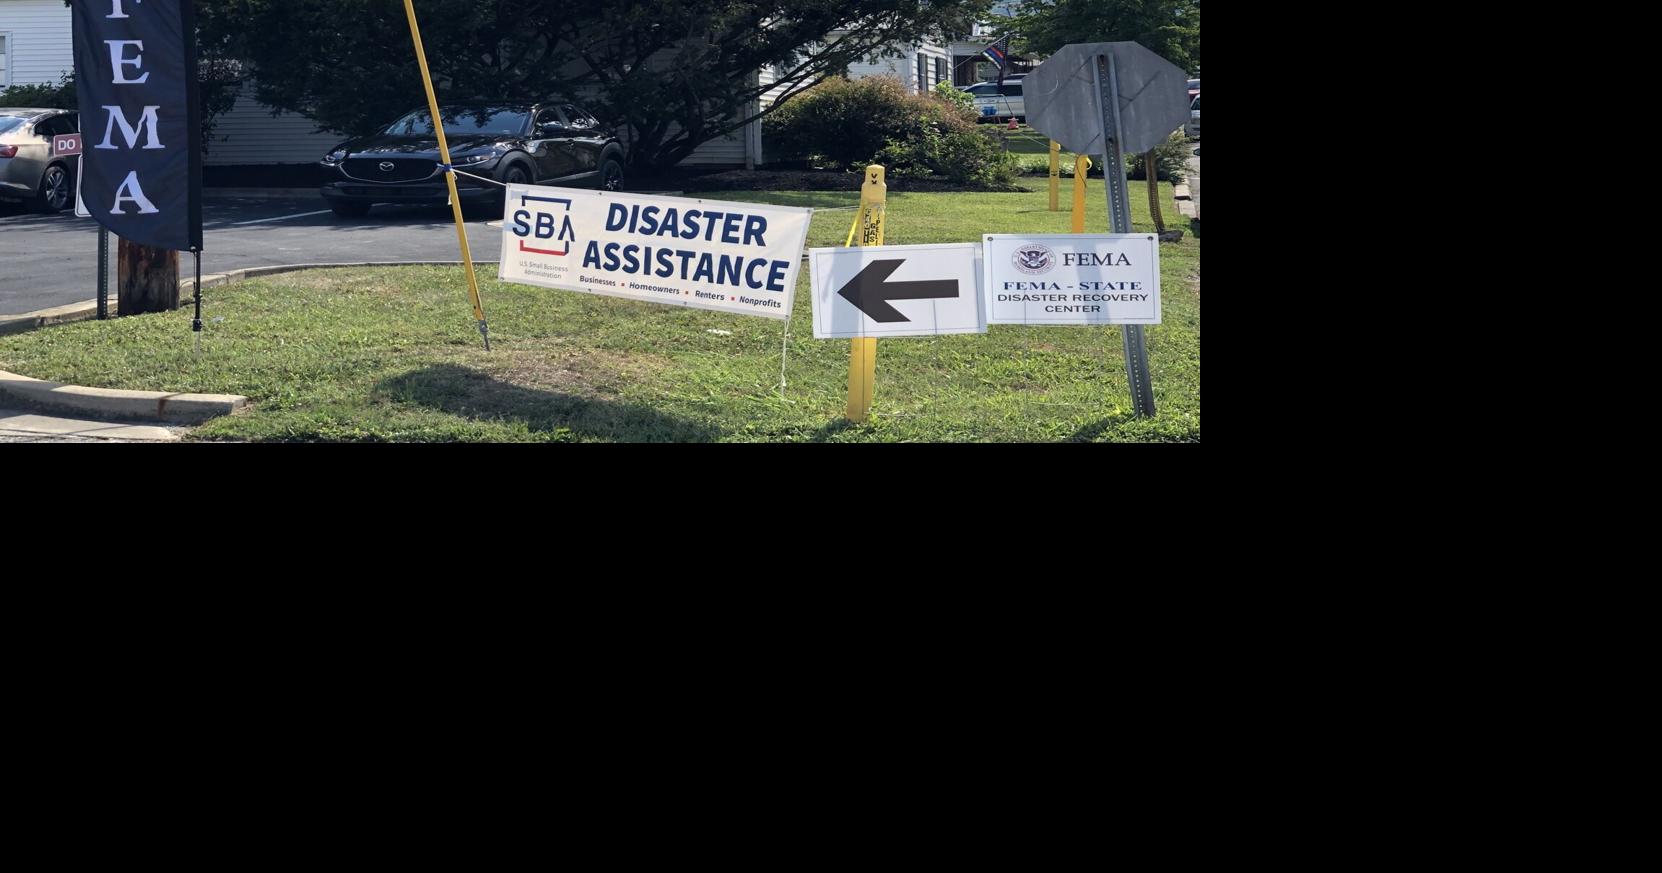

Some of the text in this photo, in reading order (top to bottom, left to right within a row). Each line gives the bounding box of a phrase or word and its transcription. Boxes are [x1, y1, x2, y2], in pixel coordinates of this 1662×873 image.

[58, 139, 76, 151] DO
[512, 209, 576, 242] SBA
[605, 202, 768, 247] DISASTER
[1062, 252, 1132, 266] FEMA
[530, 261, 543, 269] Small
[544, 264, 569, 272] Business
[582, 240, 790, 292] ASSISTANCE
[579, 275, 782, 308] Businesses Homeowners Renters Nonprofits
[1003, 281, 1061, 291] FEMA
[1079, 281, 1142, 291] STATE
[997, 293, 1149, 302] DISASTER RECOVERY
[1045, 305, 1101, 313] CENTER
